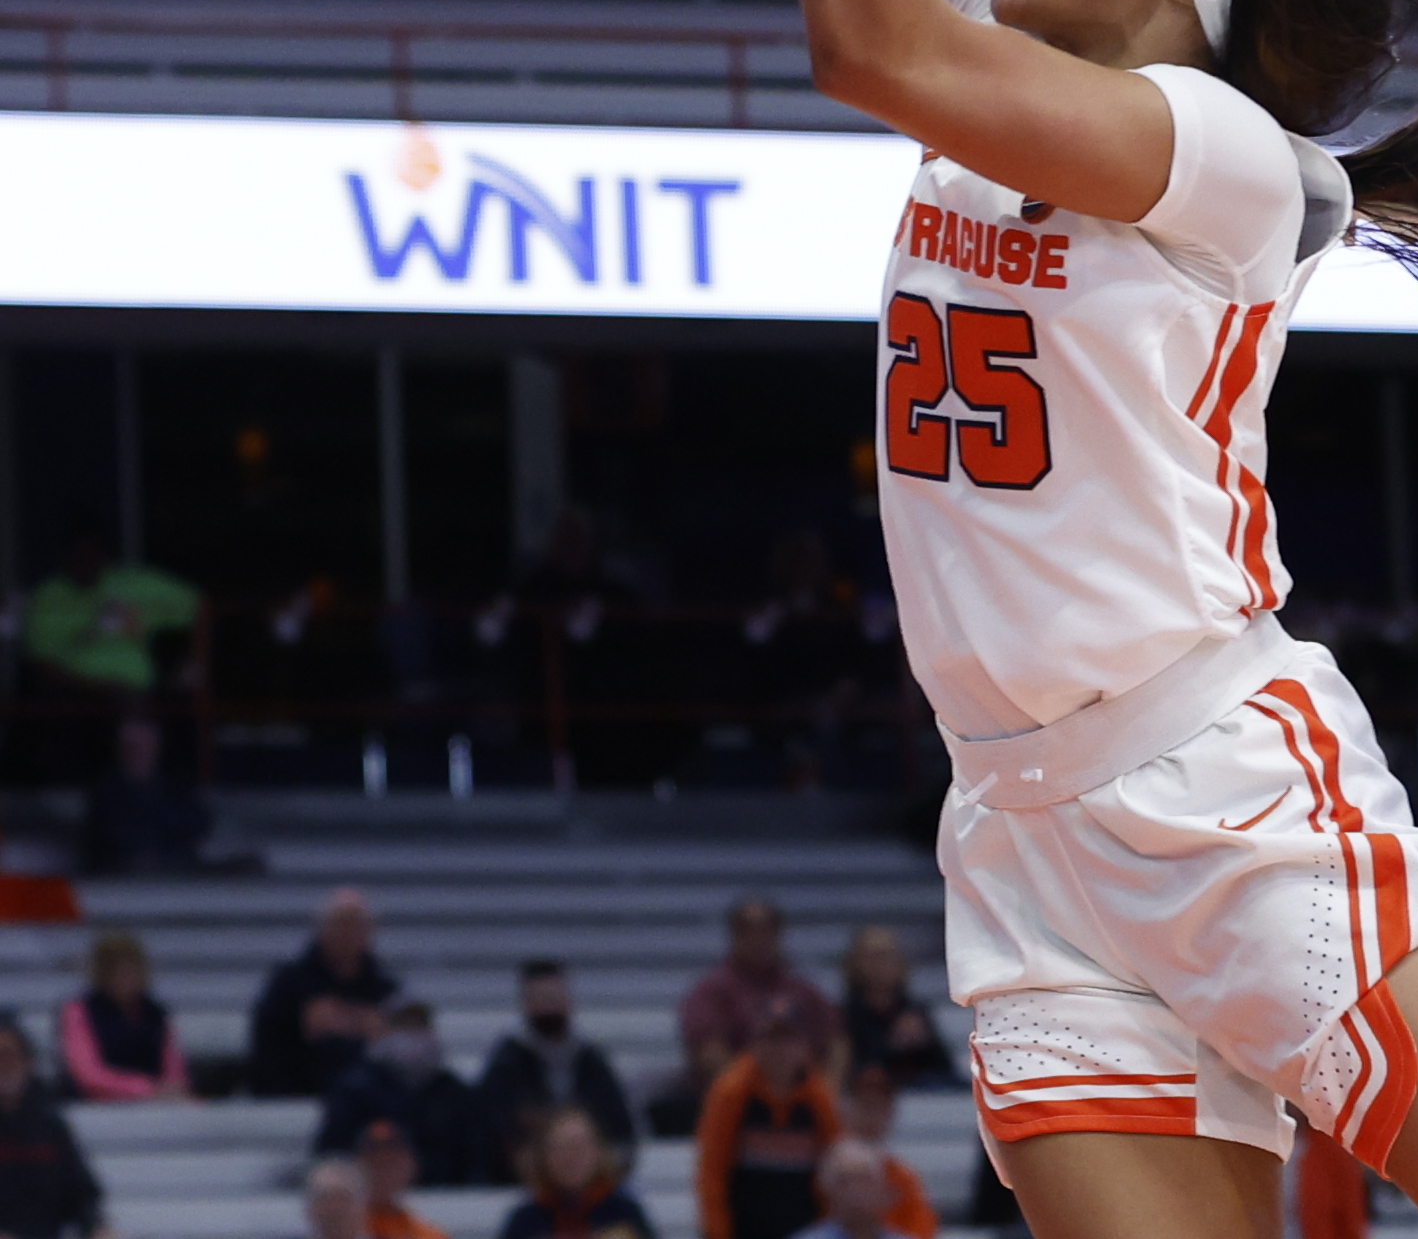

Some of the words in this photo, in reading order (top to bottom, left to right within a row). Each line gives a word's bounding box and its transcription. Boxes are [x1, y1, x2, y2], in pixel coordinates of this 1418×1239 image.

[344, 152, 743, 287] WNIT
[894, 194, 1070, 290] RACUSE
[886, 289, 1053, 490] 25
